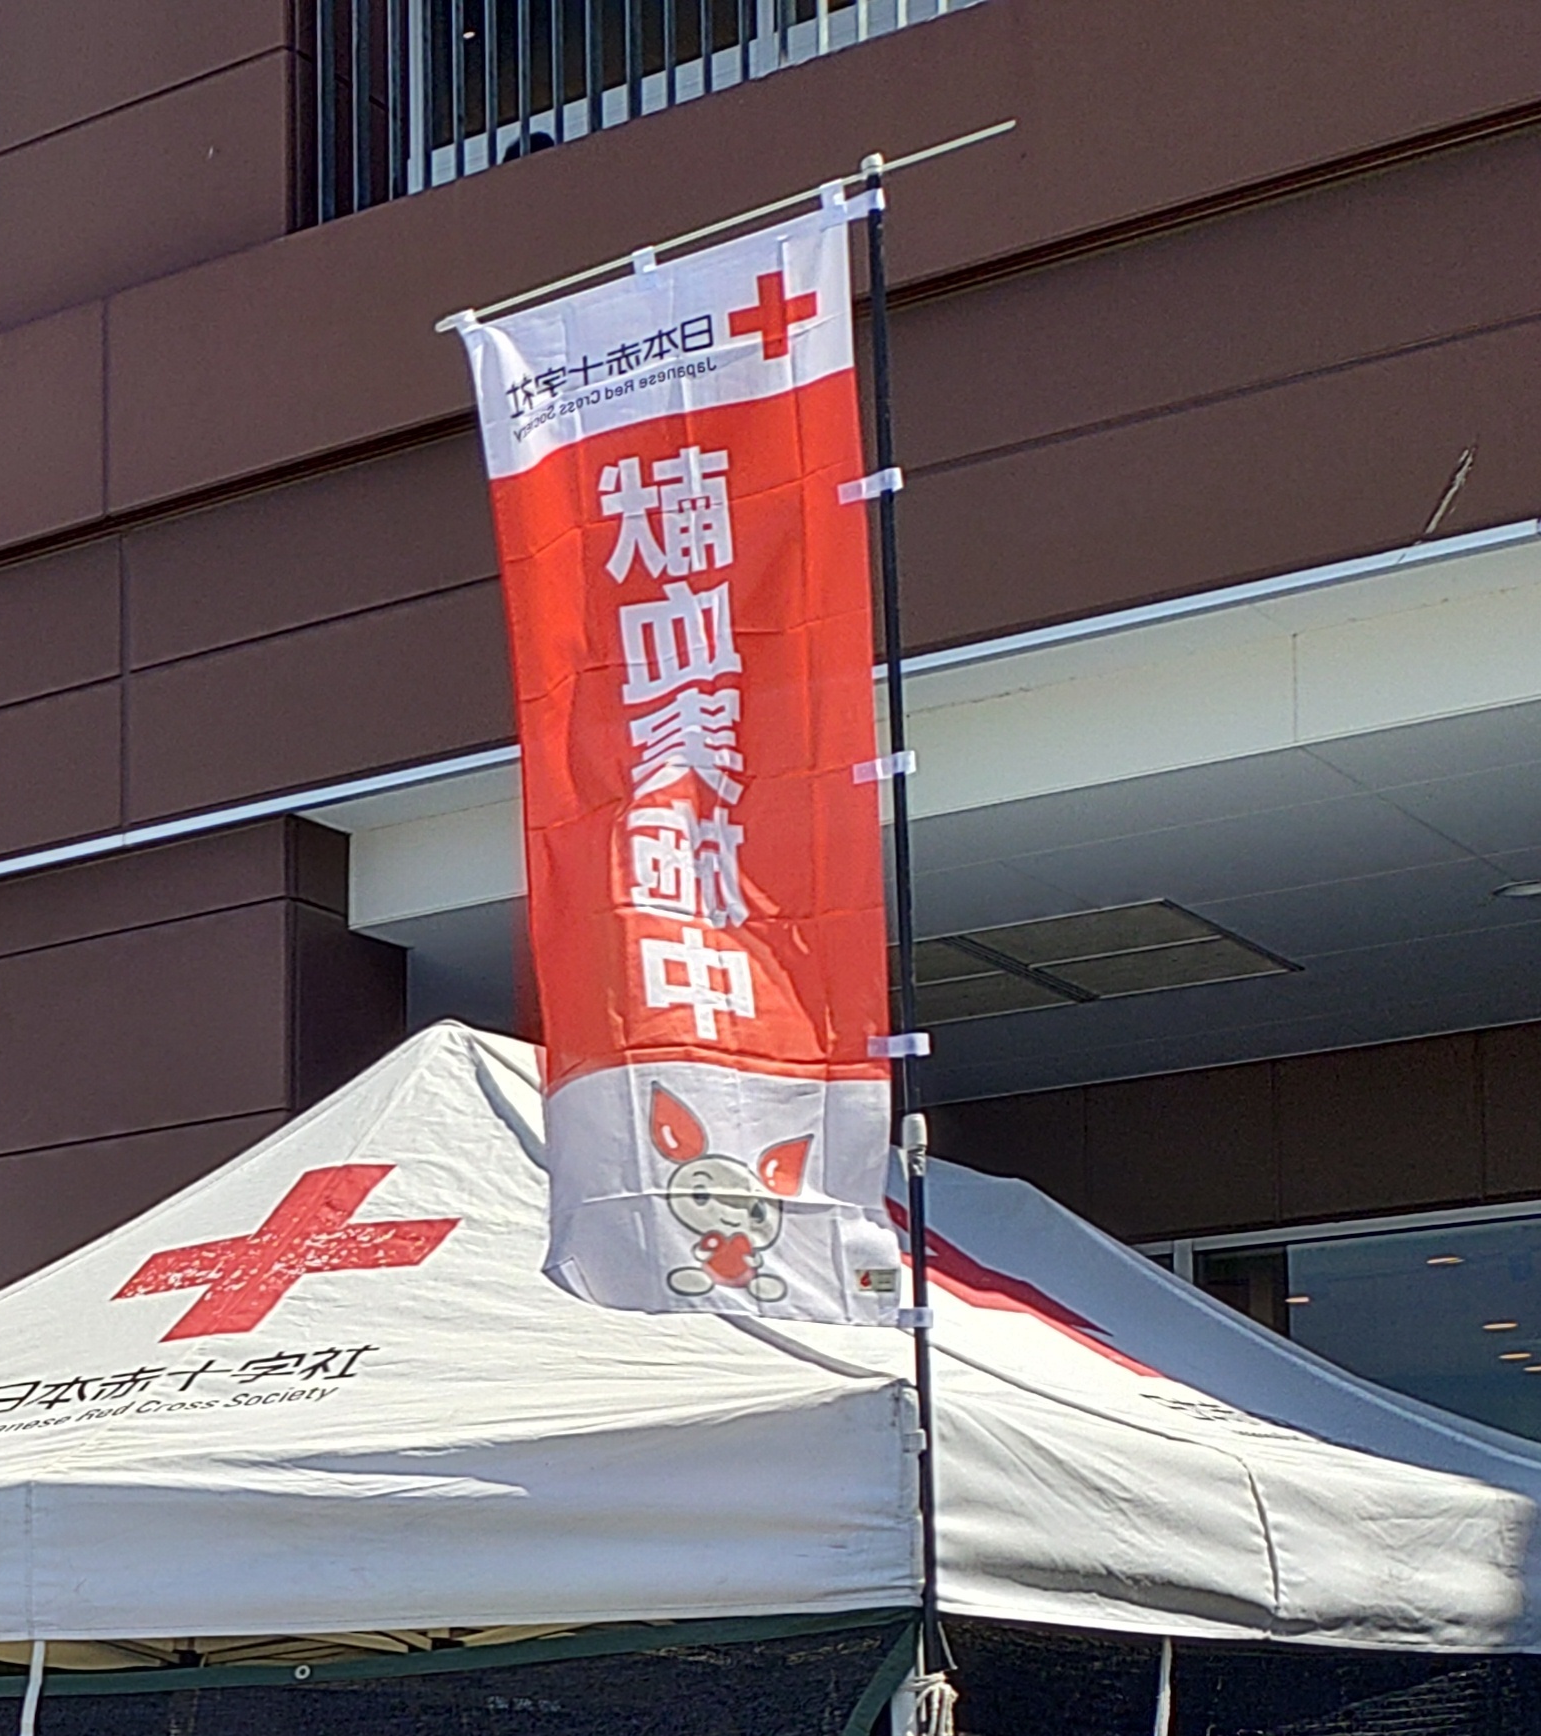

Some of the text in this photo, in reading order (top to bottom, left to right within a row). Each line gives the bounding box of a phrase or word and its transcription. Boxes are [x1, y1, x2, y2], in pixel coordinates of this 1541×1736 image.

[78, 1402, 131, 1422] Red
[134, 1398, 221, 1415] Cross
[221, 1384, 341, 1408] Society
